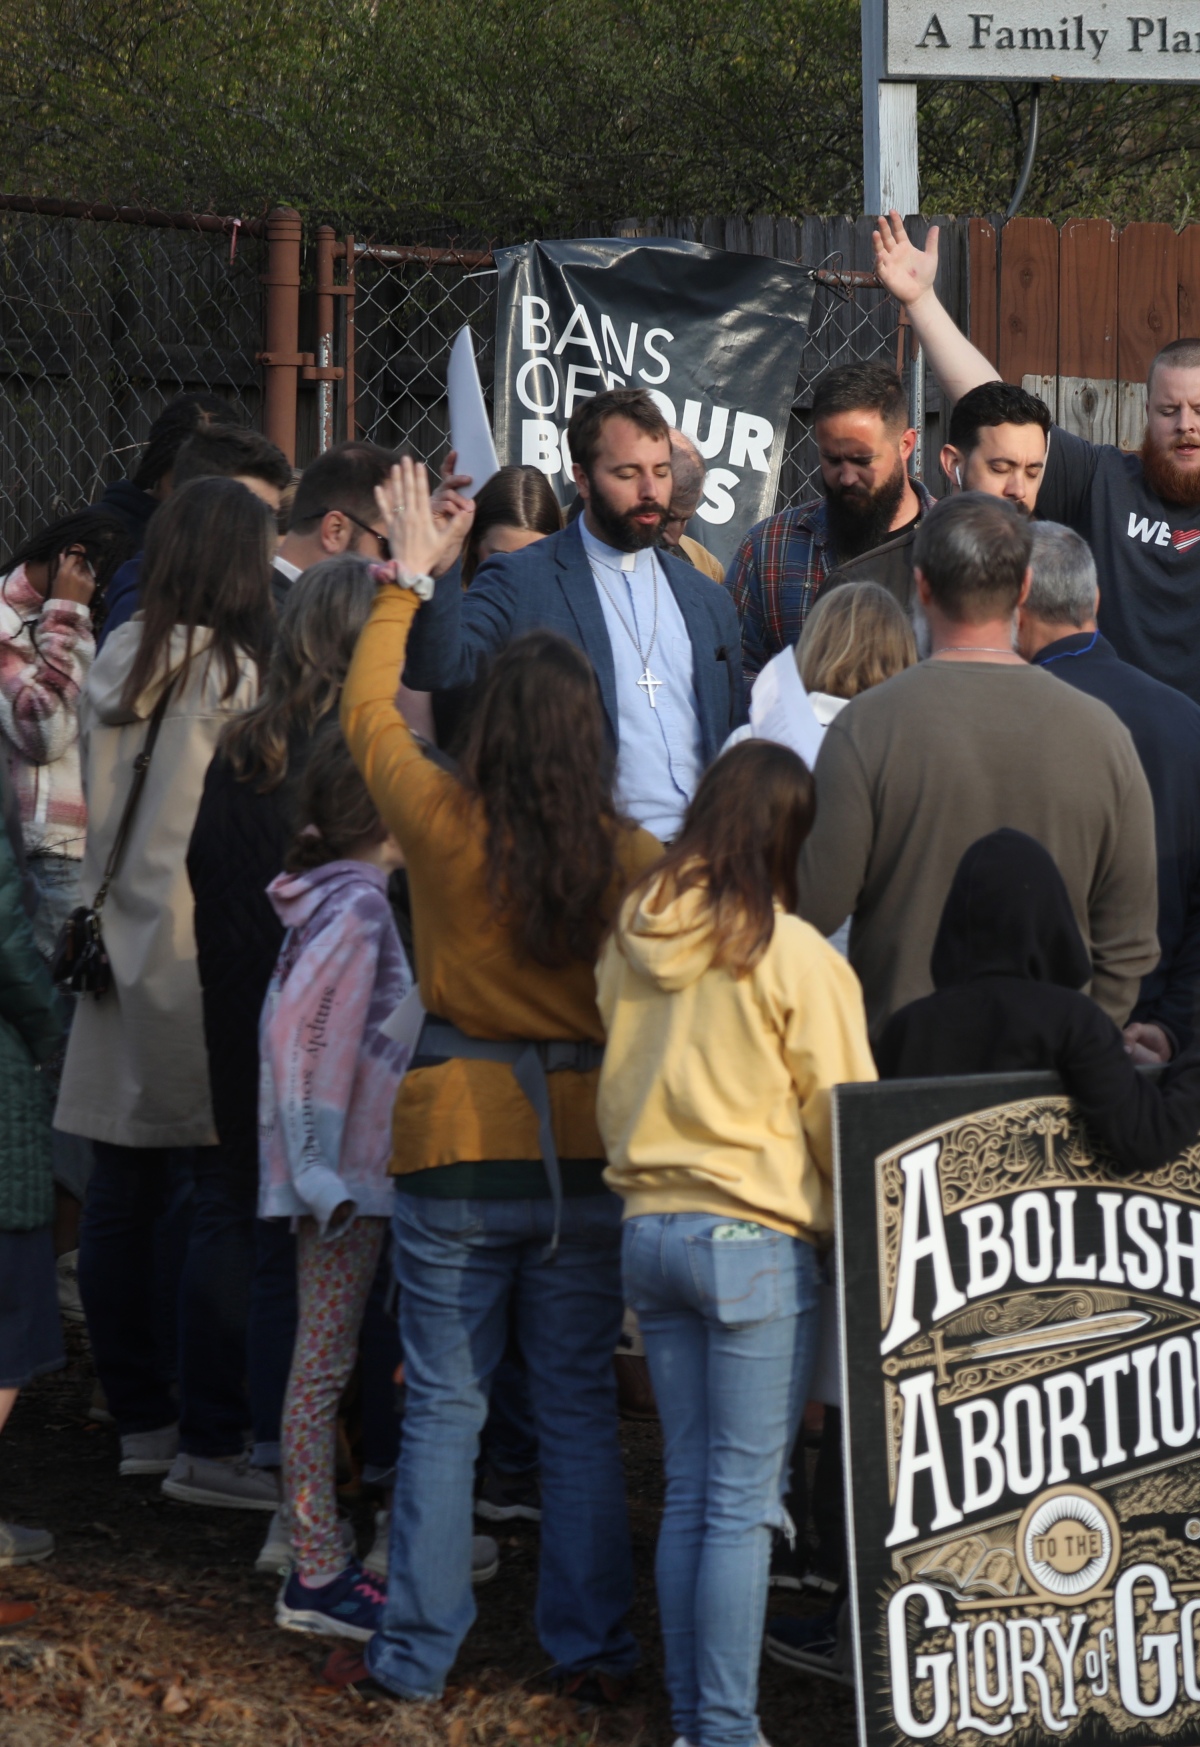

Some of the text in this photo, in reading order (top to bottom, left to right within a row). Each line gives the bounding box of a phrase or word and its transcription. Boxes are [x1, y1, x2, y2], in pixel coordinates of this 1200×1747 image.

[915, 13, 951, 49] A
[968, 14, 1109, 60] Family
[521, 295, 675, 385] BANS
[1127, 512, 1172, 547] WE
[1035, 1532, 1100, 1560] TO THE
[887, 1583, 1088, 1739] GLORY
[1085, 1627, 1115, 1697] of
